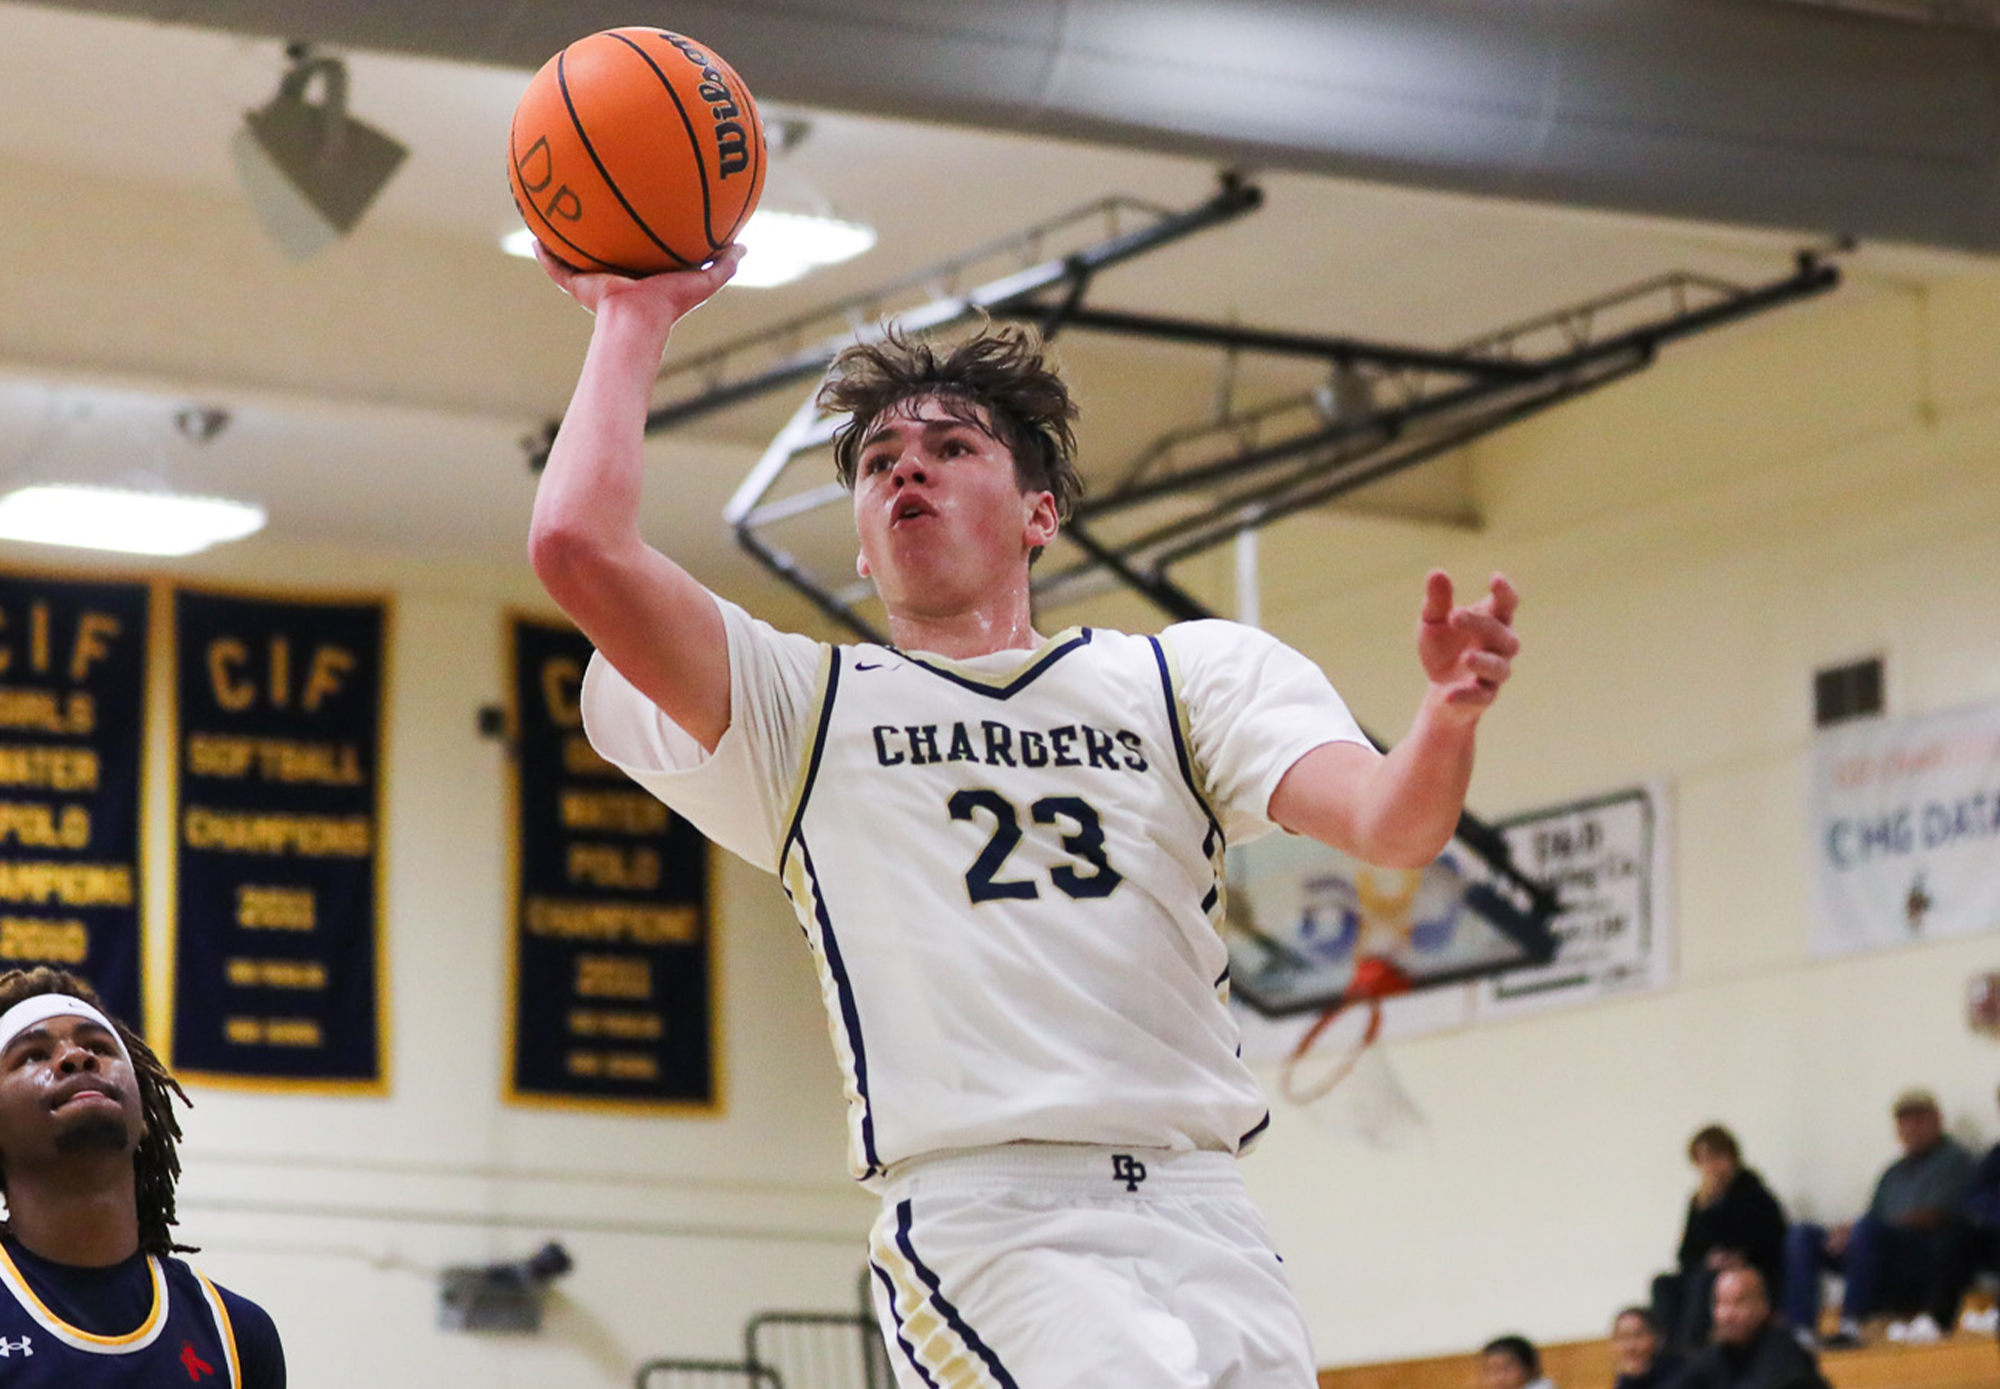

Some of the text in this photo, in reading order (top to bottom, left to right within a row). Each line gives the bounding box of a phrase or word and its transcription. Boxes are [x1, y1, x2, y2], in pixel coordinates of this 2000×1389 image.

[659, 33, 750, 180] Wilson
[207, 636, 356, 712] CIF
[0, 747, 101, 791] ATER
[872, 720, 1149, 773] CHARGERS
[946, 787, 1125, 905] 23
[0, 862, 134, 906] AMPIONS
[1110, 1153, 1148, 1193] DP
